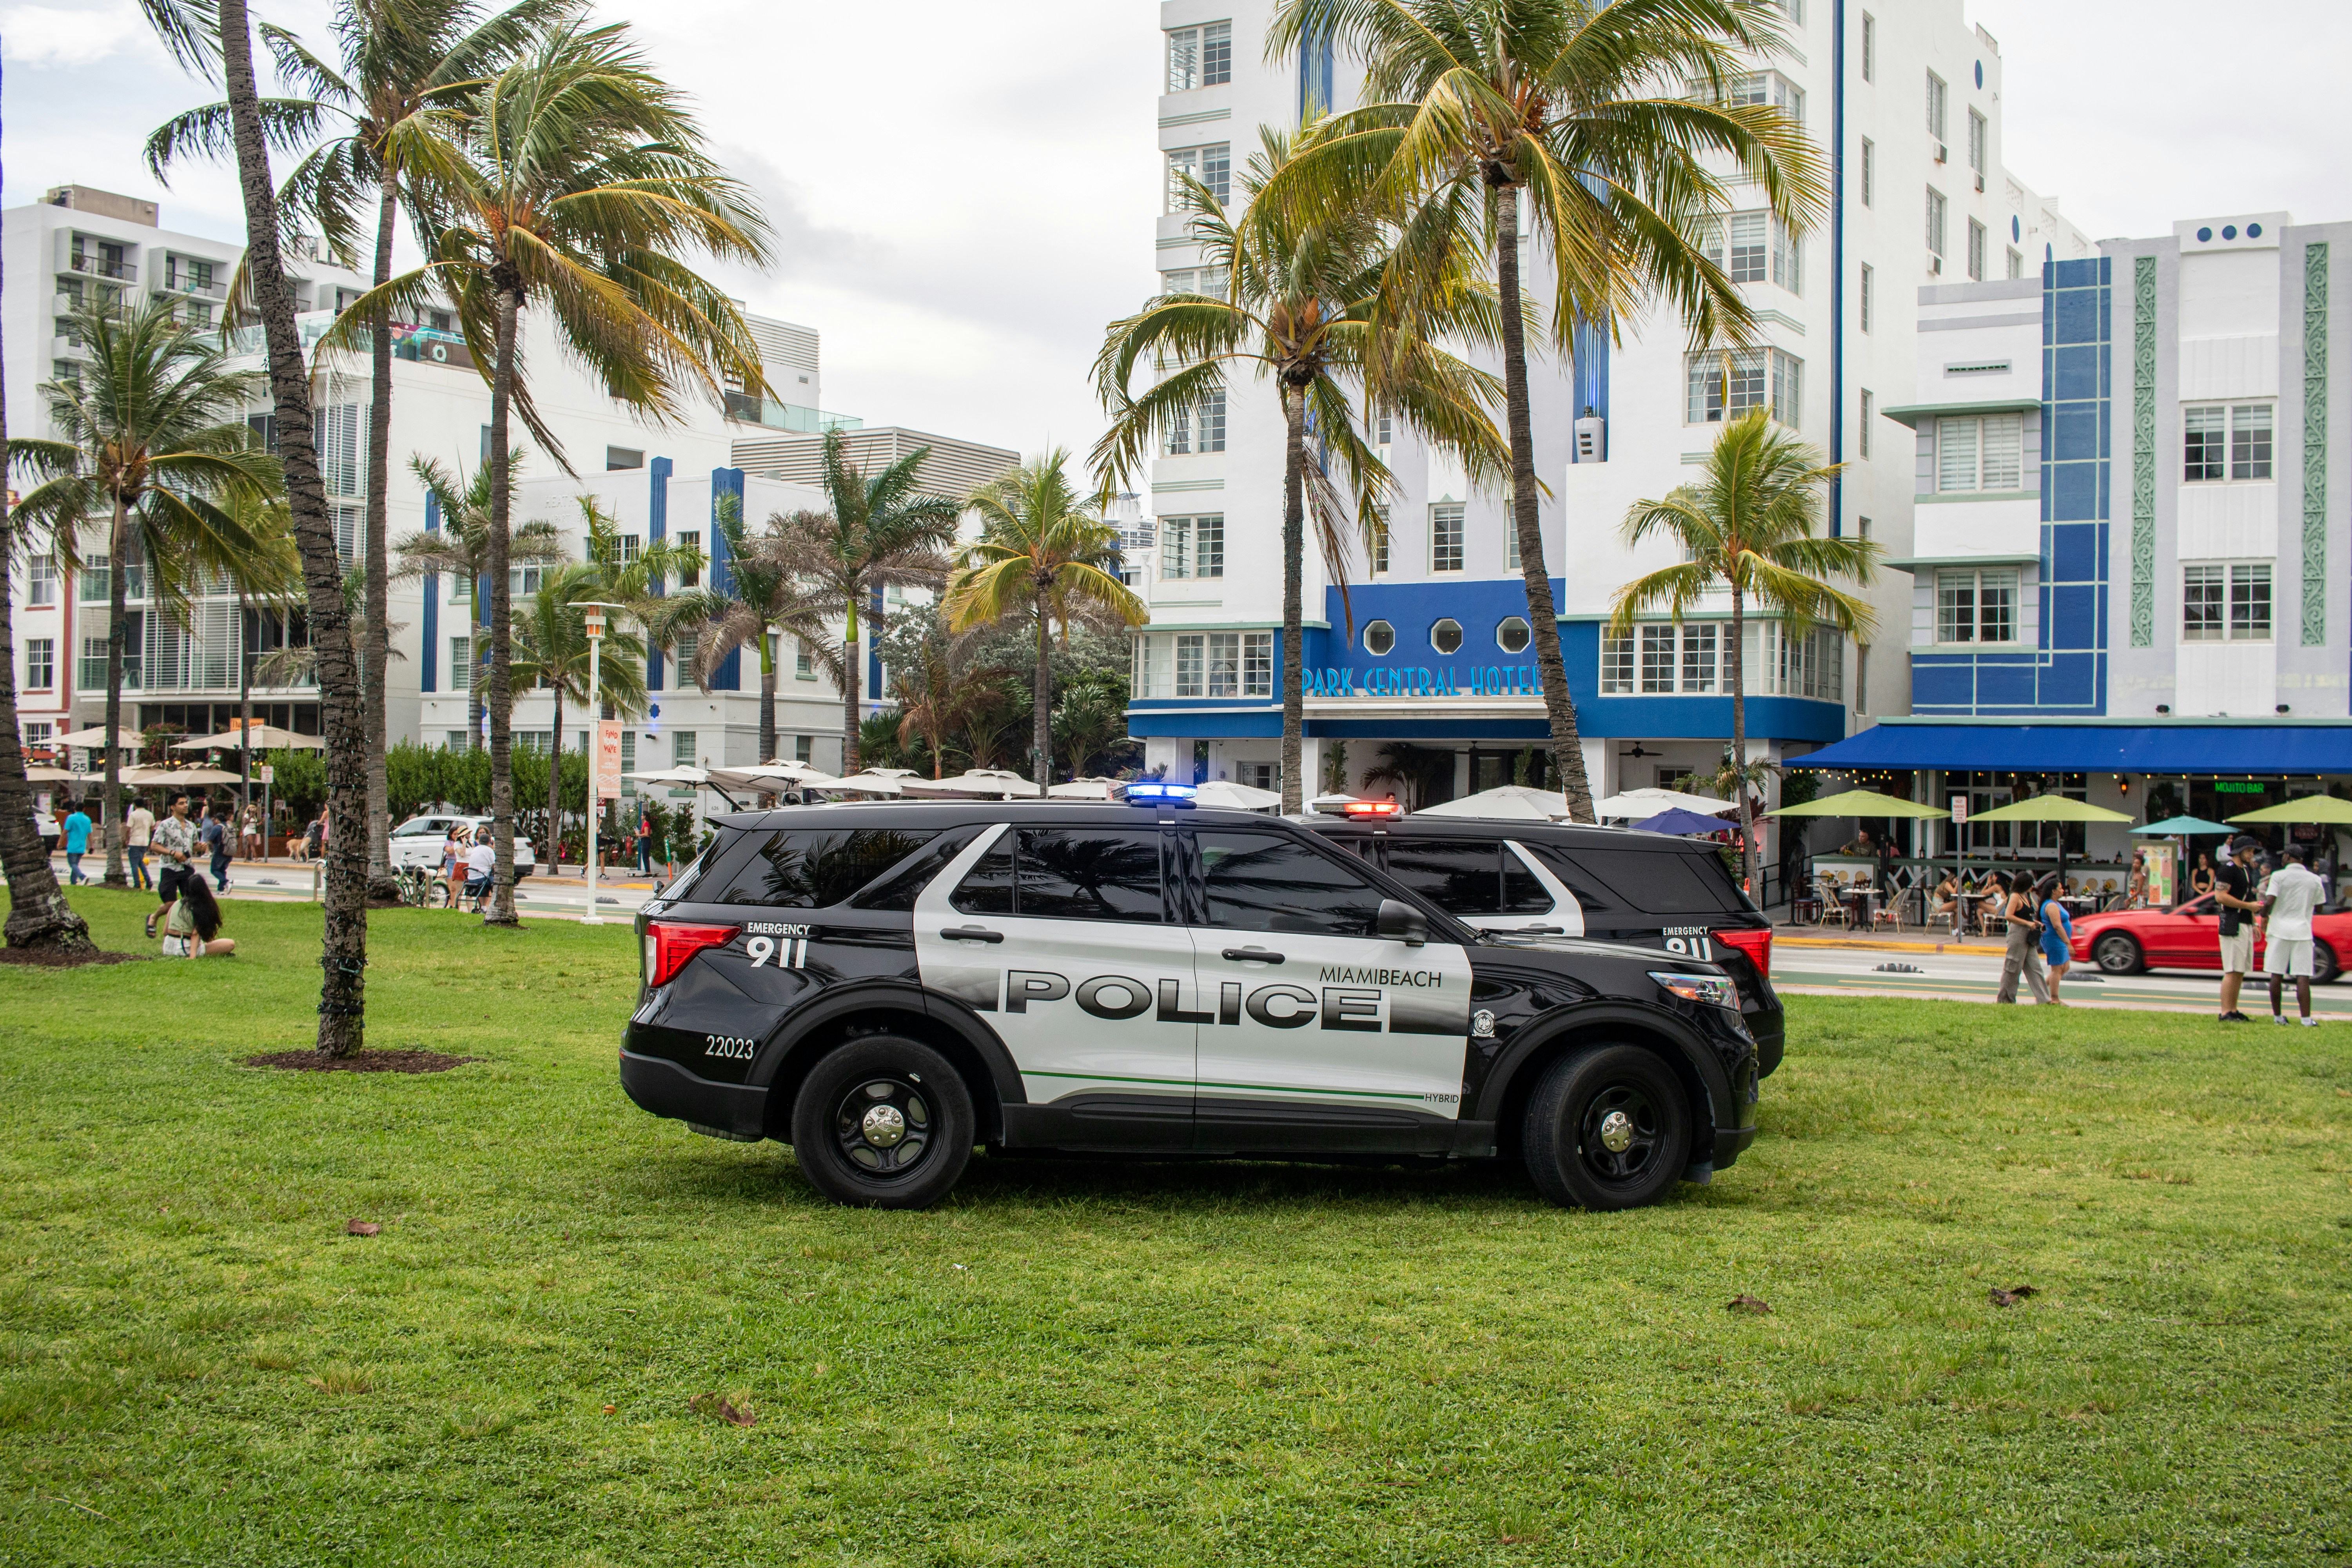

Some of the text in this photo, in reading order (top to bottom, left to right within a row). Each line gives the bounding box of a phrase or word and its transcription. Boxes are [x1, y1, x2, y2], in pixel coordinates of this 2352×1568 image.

[1302, 666, 1544, 697] PARK CENTRAL HOTEL
[606, 730, 618, 739] FIND
[603, 737, 618, 746] YOUR
[604, 745, 617, 753] WAVE
[73, 763, 87, 772] 25
[2215, 782, 2265, 793] MOJITO BAR
[747, 922, 811, 935] EMERGENCY
[1662, 926, 1708, 936] EMERGENCY
[747, 936, 808, 969] 911
[1319, 965, 1441, 987] MIAMIBEACH
[1005, 969, 1382, 1033] POLICE
[705, 1035, 754, 1060] 22023
[1425, 1093, 1459, 1103] HYBRID
